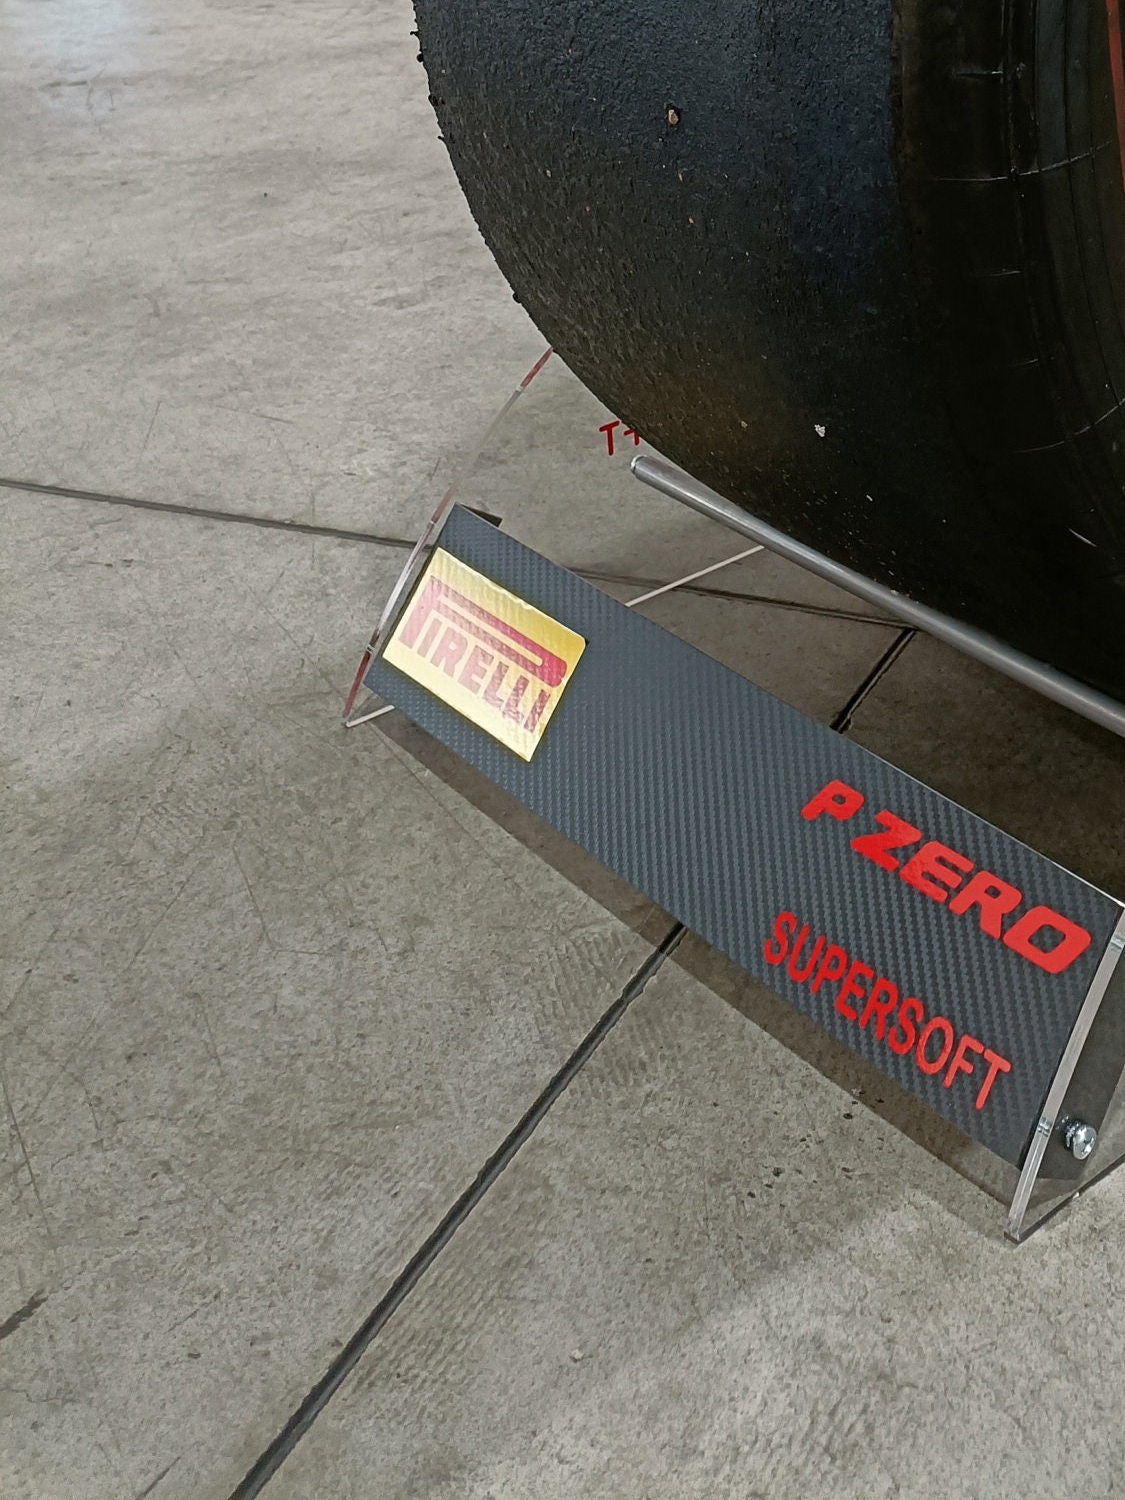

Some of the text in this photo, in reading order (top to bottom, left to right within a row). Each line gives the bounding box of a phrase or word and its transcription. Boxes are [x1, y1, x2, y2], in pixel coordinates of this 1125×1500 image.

[398, 576, 567, 733] PIRELLI
[801, 779, 1092, 974] P ZERO
[763, 911, 1012, 1111] SUPERSOFT
